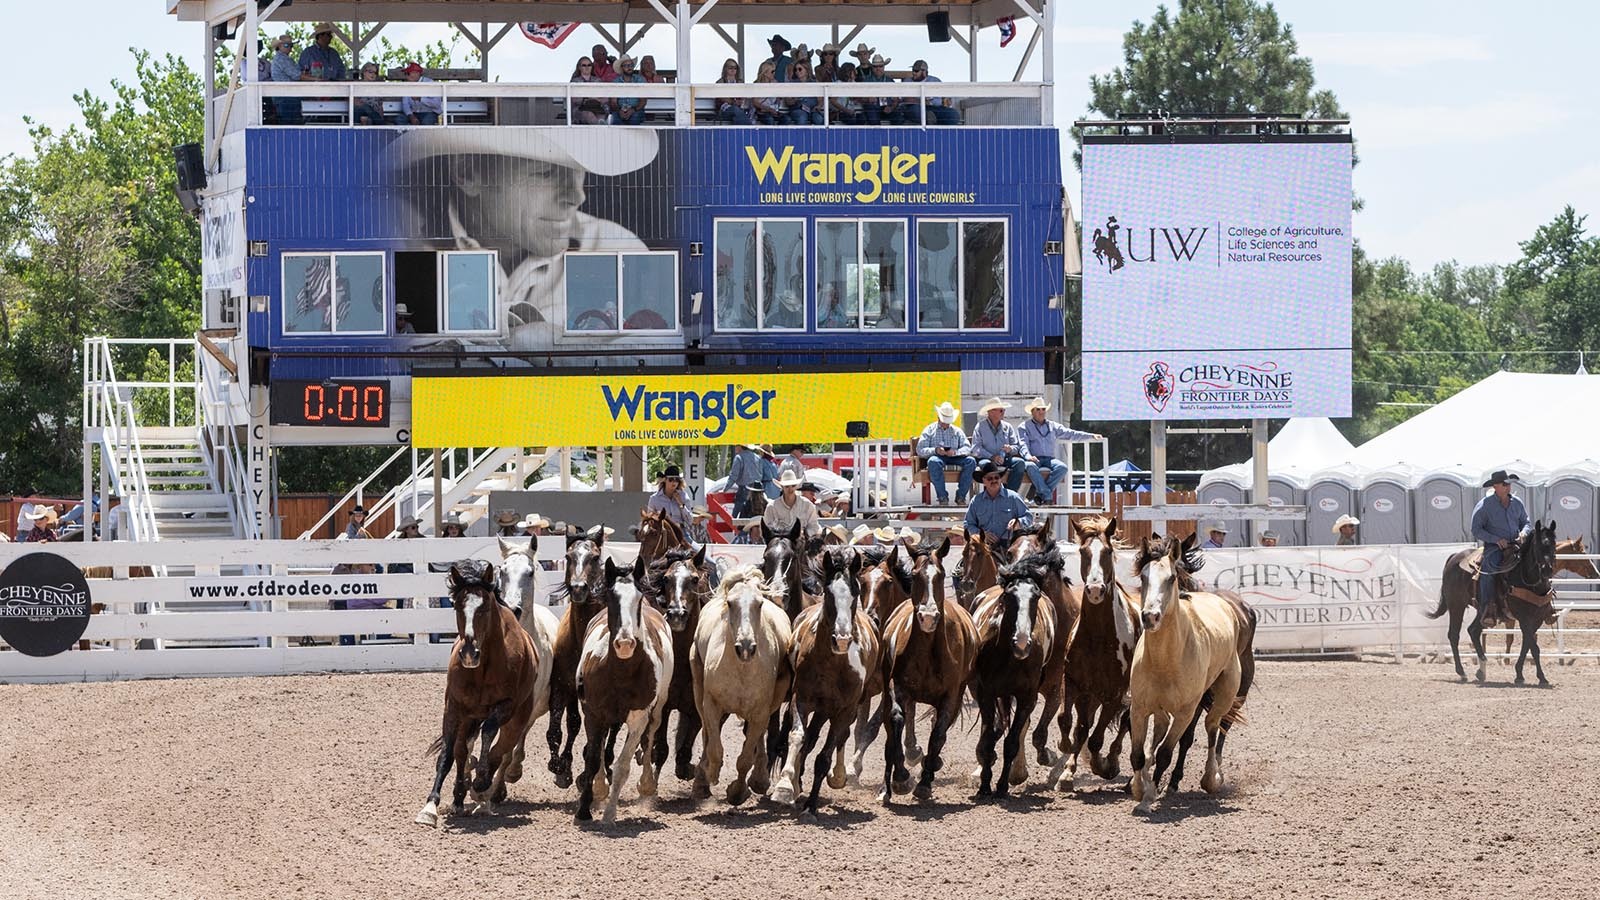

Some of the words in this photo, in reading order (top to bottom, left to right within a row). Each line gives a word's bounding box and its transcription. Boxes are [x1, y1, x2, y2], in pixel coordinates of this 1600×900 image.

[745, 145, 936, 204] Wrangler
[760, 193, 783, 203] LONG
[786, 193, 805, 203] LIVE
[808, 192, 852, 203] COWBOYS
[882, 193, 905, 203] LONG
[908, 193, 926, 203] LIVE
[929, 192, 975, 203] COWGIRLS
[1227, 226, 1267, 238] College
[1270, 226, 1281, 236] of
[1284, 226, 1344, 238] Agriculture,
[1126, 227, 1209, 262] UW
[1228, 239, 1247, 250] Life
[1250, 239, 1295, 250] Sciences
[1297, 238, 1318, 249] and
[1228, 252, 1266, 262] Natural
[1269, 252, 1322, 262] Resources
[1179, 364, 1292, 389] CHEYENNE
[1181, 391, 1249, 402] FRONTIER
[1254, 391, 1289, 401] DAYS
[601, 383, 777, 439] Wrangler
[614, 430, 636, 440] LONG
[638, 430, 656, 440] LIVE
[658, 429, 699, 440] COWBOYS
[189, 580, 378, 598] www.cfdrodeo.com
[1213, 562, 1397, 601] CHEYENNE
[0, 585, 87, 606] CHEYENNE
[0, 607, 53, 616] FRONTIER
[56, 607, 84, 616] DAYS
[1256, 606, 1330, 625] NTIER
[1339, 604, 1391, 622] DAYS
